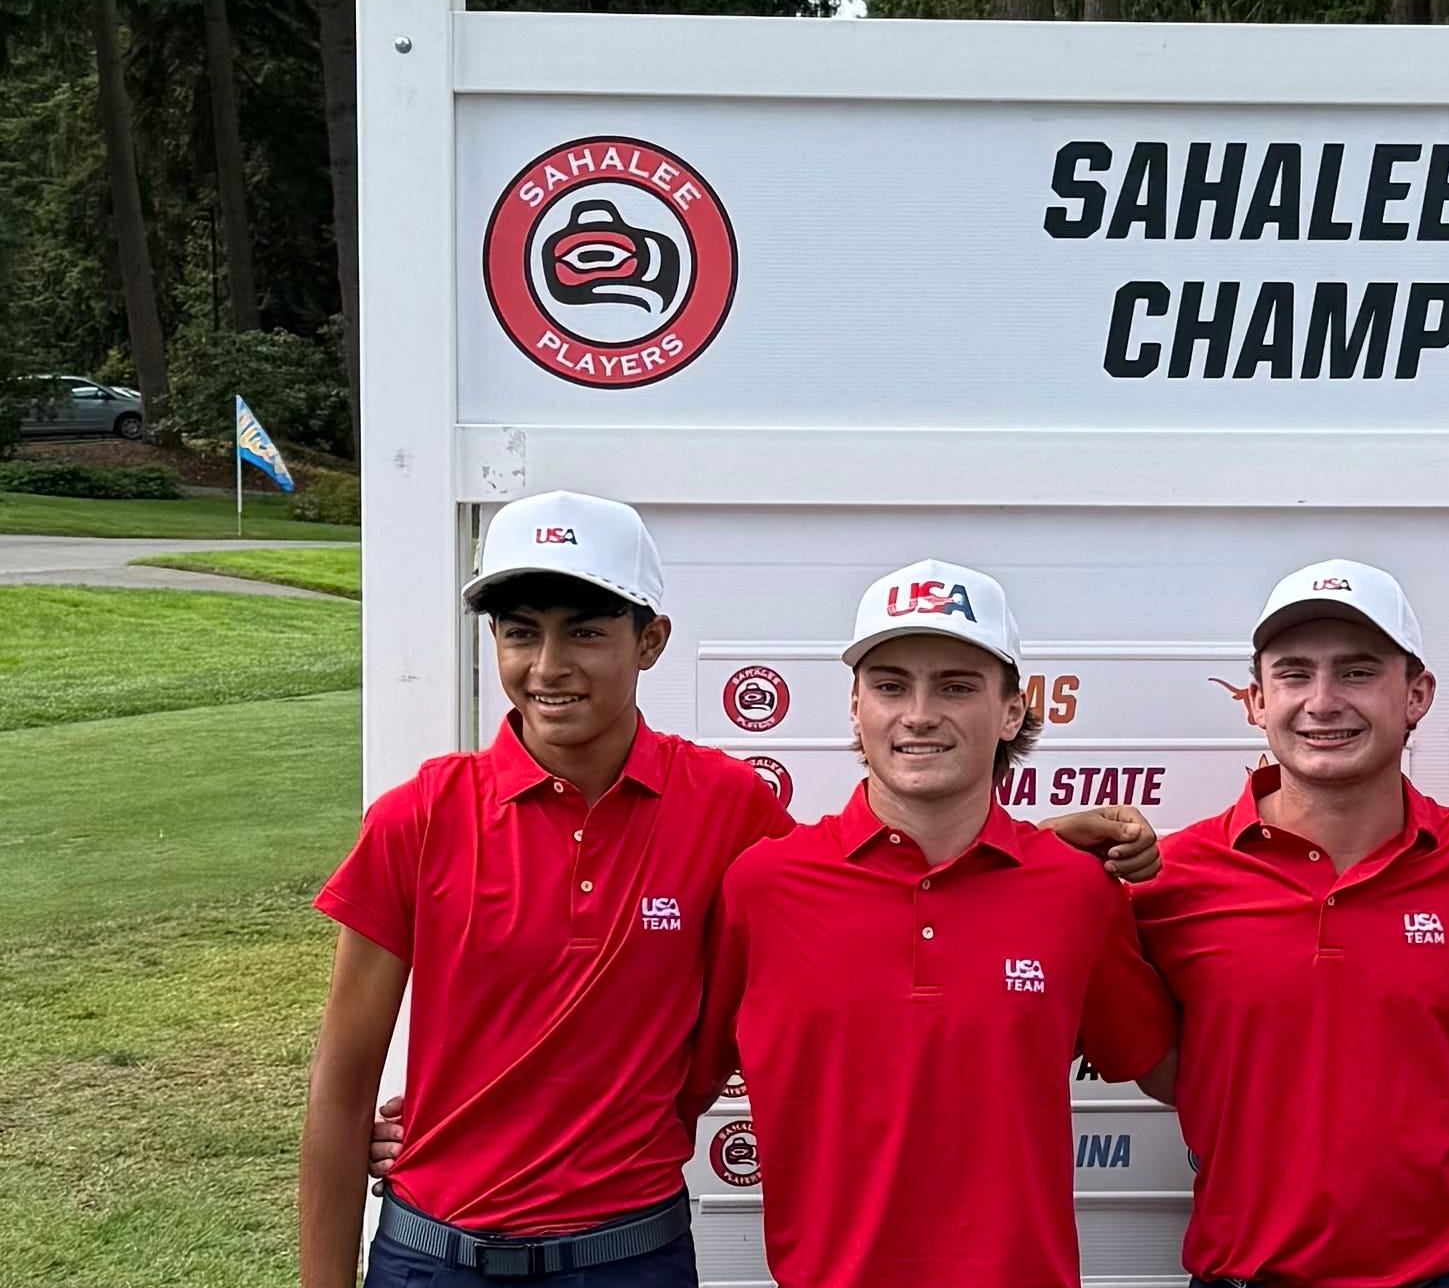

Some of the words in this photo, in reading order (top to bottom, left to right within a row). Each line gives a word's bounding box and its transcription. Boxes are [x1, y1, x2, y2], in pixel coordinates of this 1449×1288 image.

[518, 146, 702, 211] SAHALEE
[536, 330, 684, 377] PLAYERS
[535, 527, 578, 545] USA
[1312, 578, 1352, 591] USA
[887, 581, 978, 623] USA
[1050, 767, 1166, 806] STATE
[641, 897, 681, 917] USA
[641, 917, 681, 930] TEAM
[1403, 913, 1444, 931] USA
[1404, 931, 1445, 944] TEAM
[1005, 959, 1045, 980] USA
[1005, 978, 1045, 993] TEAM
